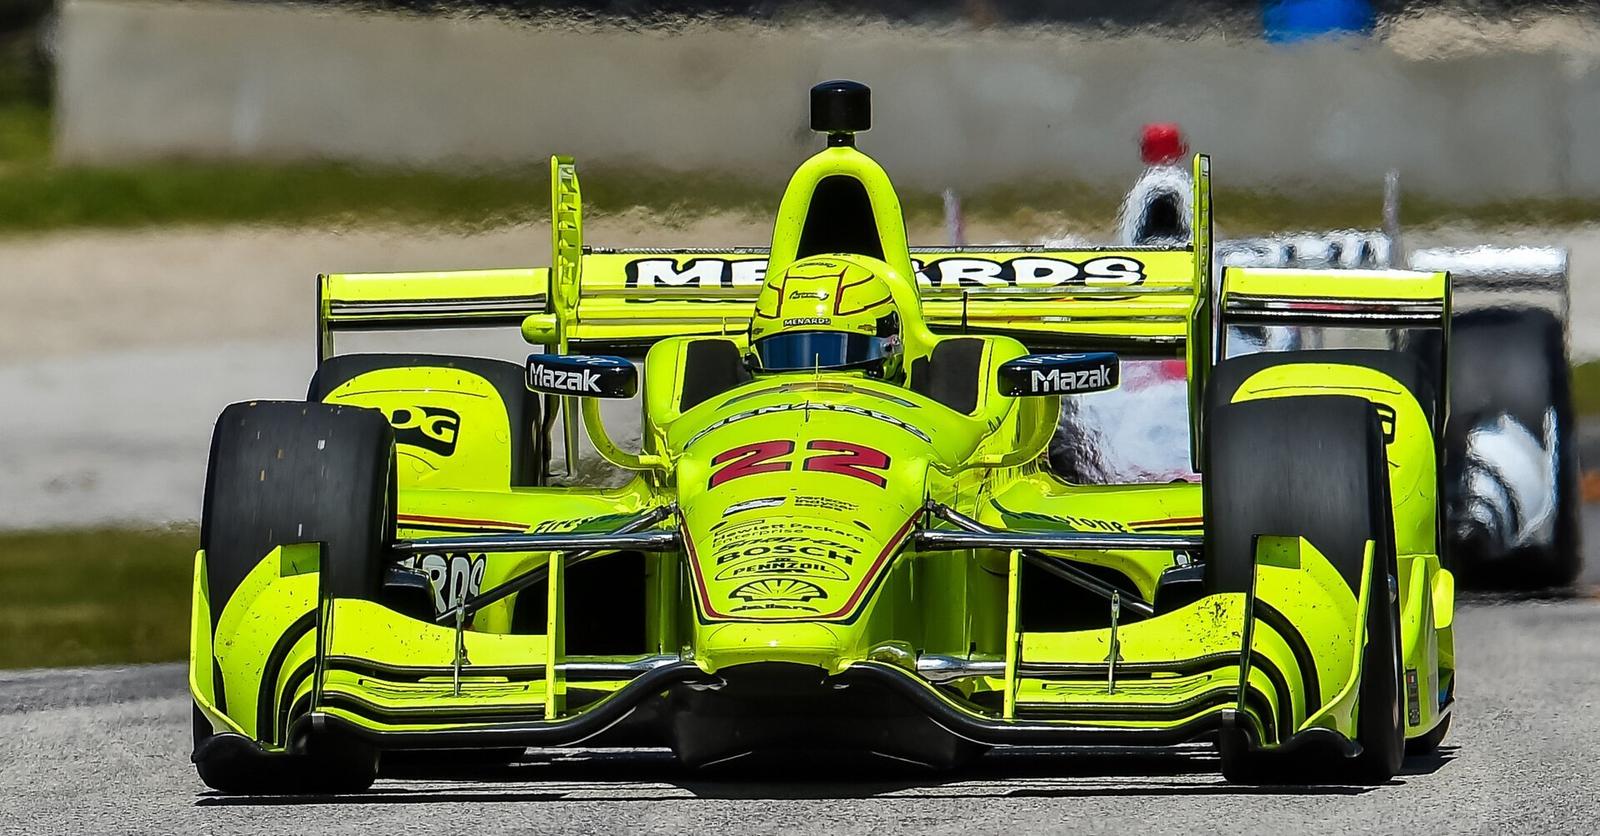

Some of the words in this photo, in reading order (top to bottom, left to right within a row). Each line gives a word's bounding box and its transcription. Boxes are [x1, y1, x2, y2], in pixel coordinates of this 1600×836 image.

[784, 318, 830, 326] MENARDS
[530, 363, 602, 392] Mazak
[1031, 365, 1111, 392] Mazak
[707, 439, 891, 491] 22
[712, 524, 785, 543] Hewlett
[790, 524, 865, 542] Packard
[712, 528, 804, 548] Enterprise
[717, 545, 853, 566] BOSCH
[733, 563, 830, 576] PENNZOIL
